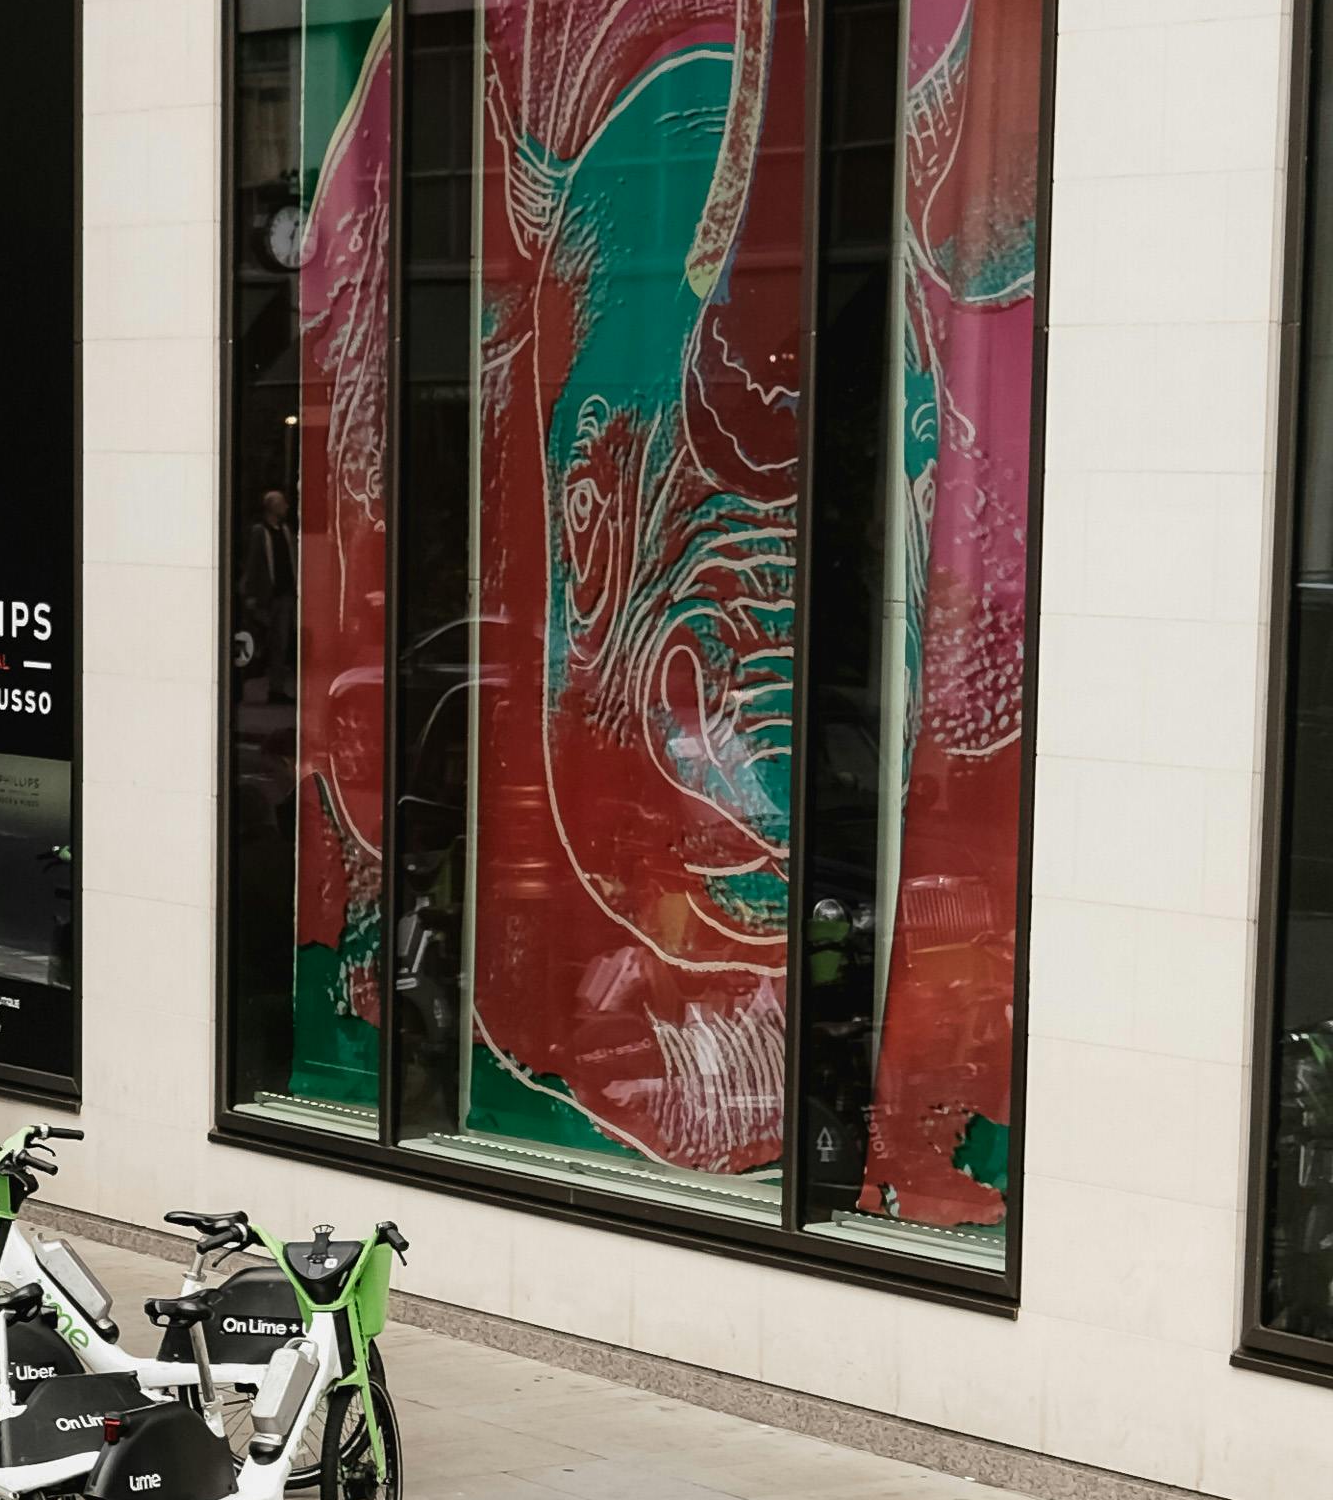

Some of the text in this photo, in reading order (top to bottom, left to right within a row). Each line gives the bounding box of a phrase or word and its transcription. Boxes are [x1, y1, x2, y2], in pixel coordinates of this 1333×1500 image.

[222, 1317, 247, 1333] On
[248, 1319, 287, 1335] Lime
[16, 1365, 55, 1381] Uber
[55, 1416, 81, 1432] On
[129, 1472, 162, 1492] Lime
